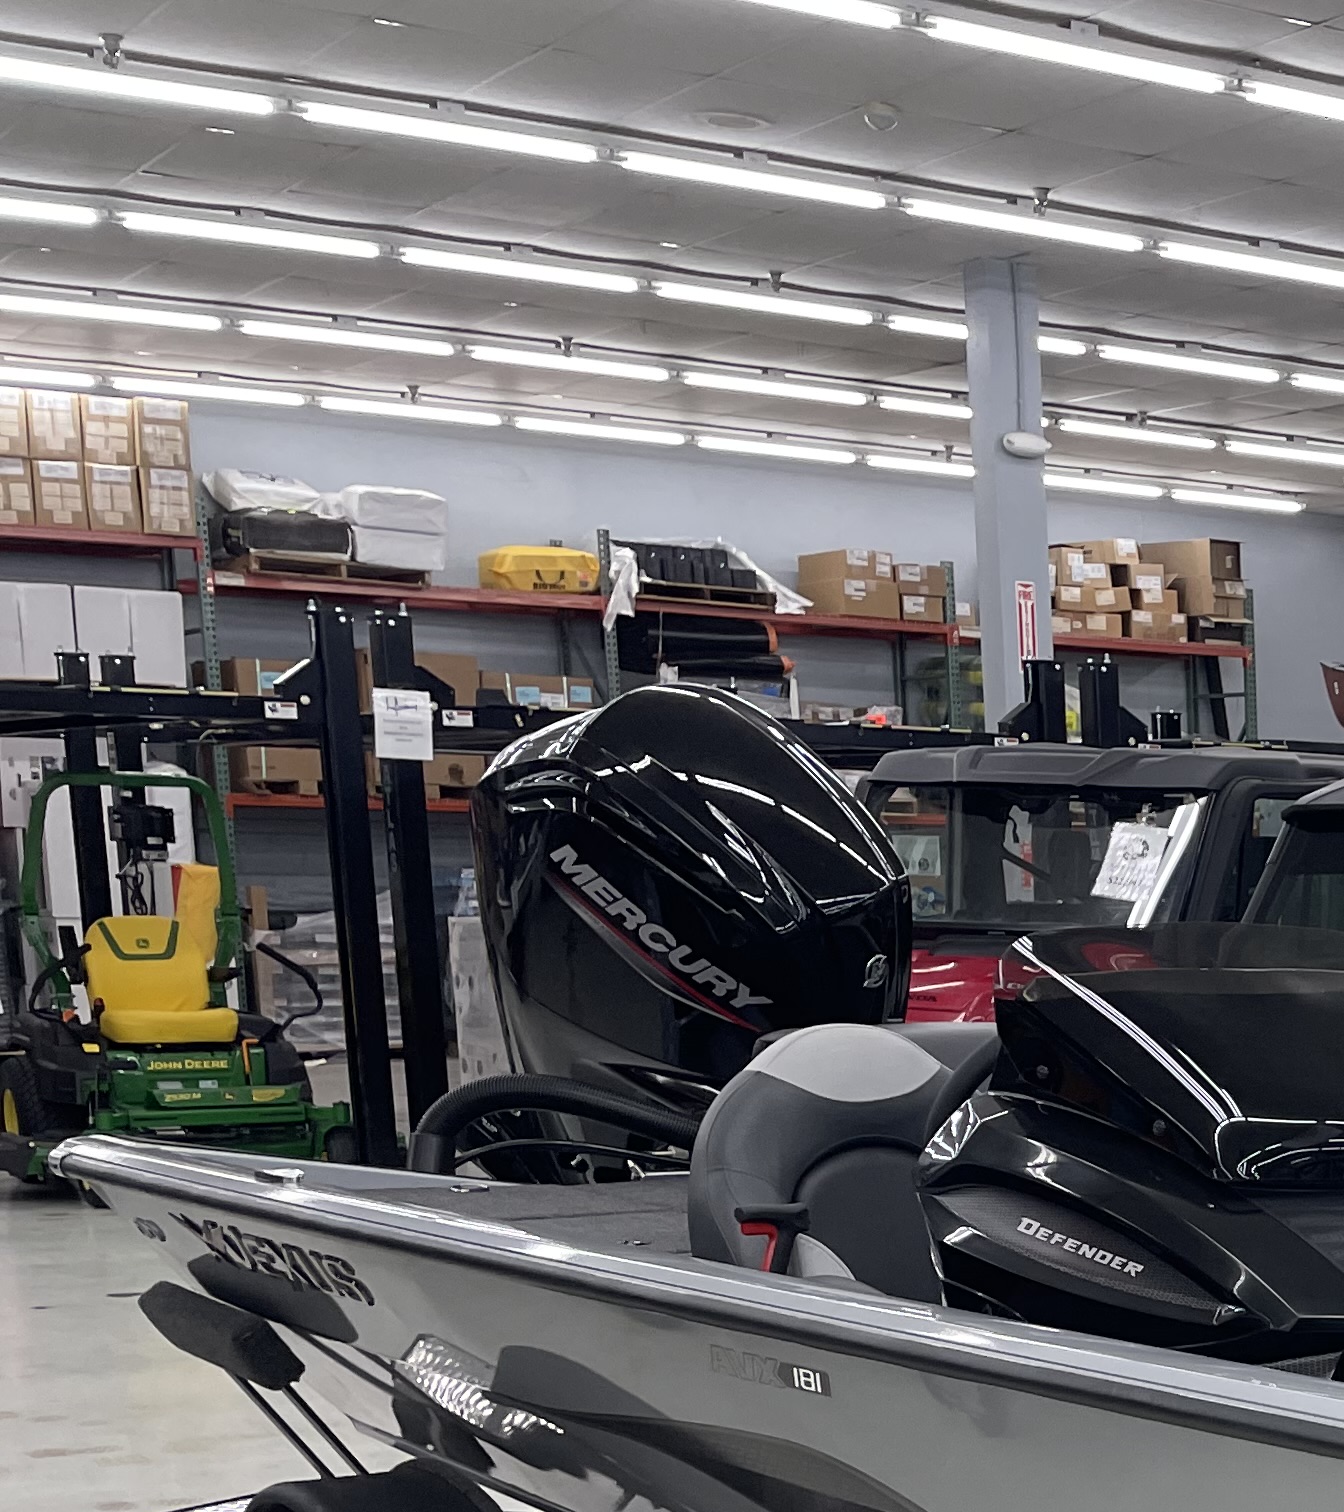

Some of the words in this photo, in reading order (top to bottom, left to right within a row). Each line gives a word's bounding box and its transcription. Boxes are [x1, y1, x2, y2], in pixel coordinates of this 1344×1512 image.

[550, 844, 774, 1009] MERCURY
[147, 1060, 182, 1070] JOHN
[184, 1059, 228, 1069] DEERE
[1016, 1217, 1145, 1278] DEFENDER
[793, 1366, 822, 1393] 181
